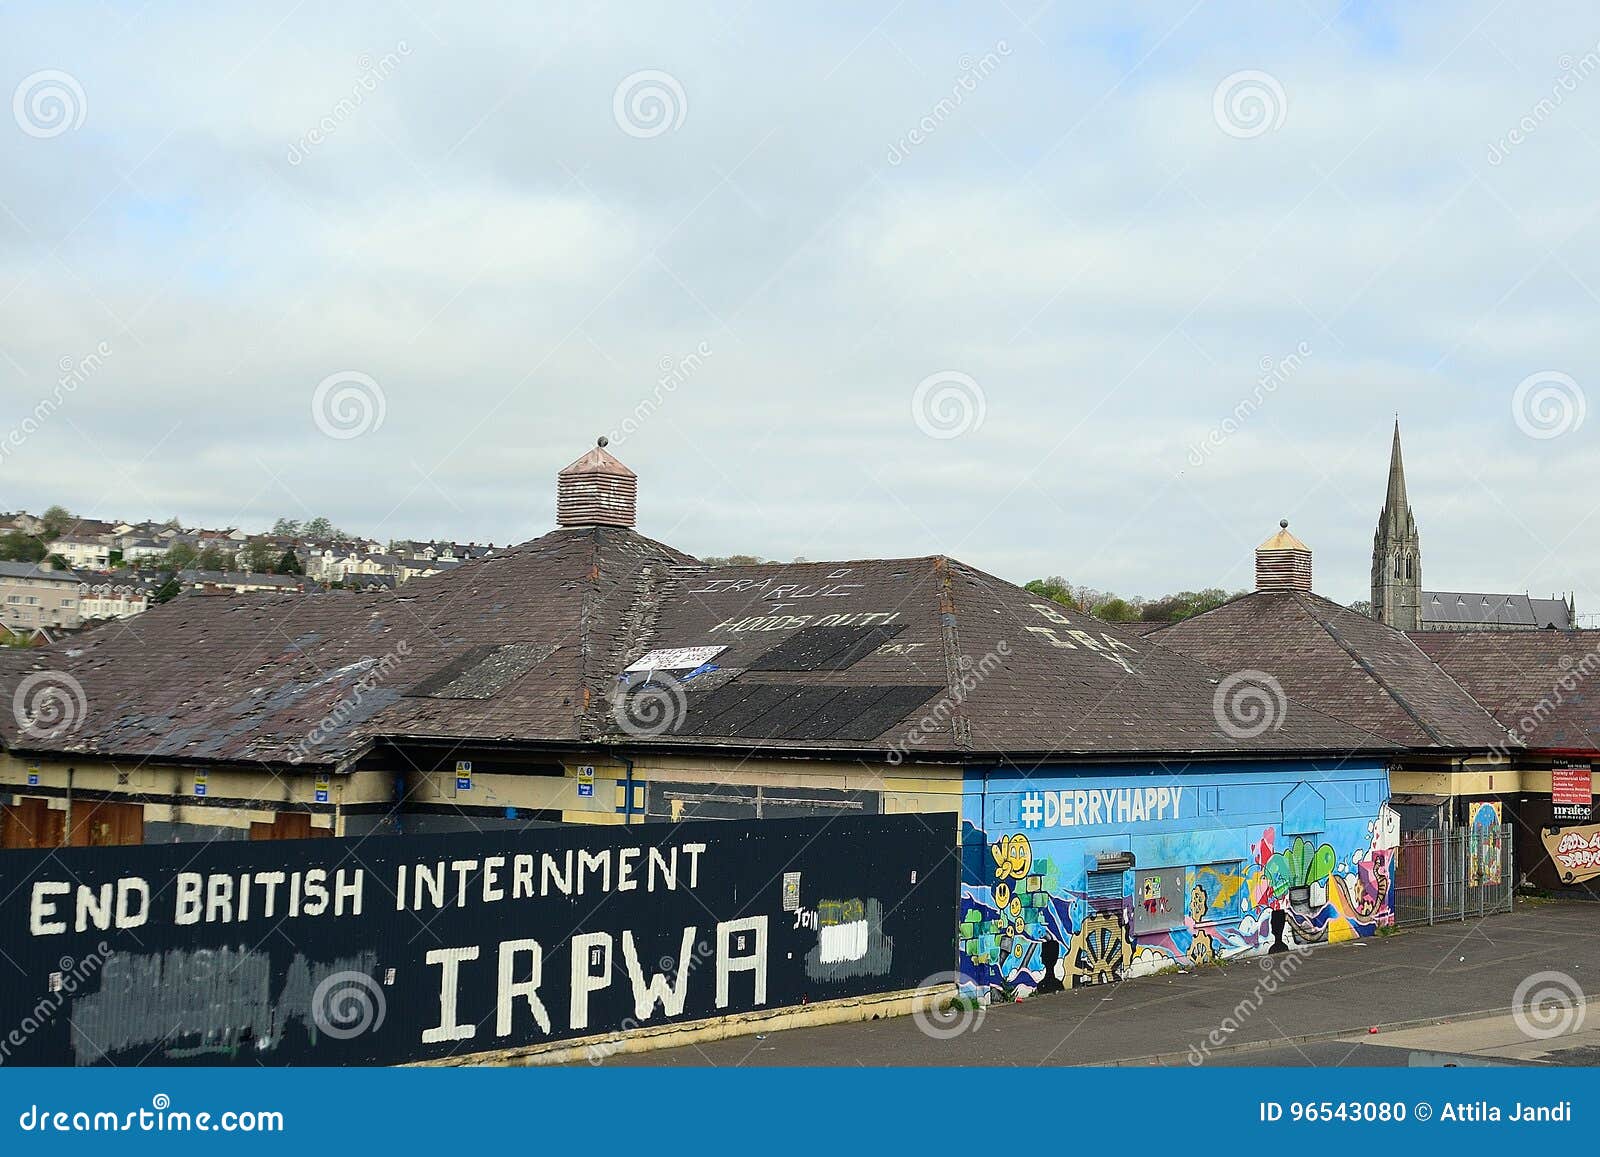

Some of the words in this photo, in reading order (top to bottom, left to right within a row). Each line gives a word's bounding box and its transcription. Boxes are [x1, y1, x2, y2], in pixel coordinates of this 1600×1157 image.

[708, 615, 814, 633] HOODS
[1021, 786, 1182, 829] #DERRYHAPPY
[30, 876, 150, 936] END
[174, 868, 364, 926] BRITISH
[396, 843, 706, 911] INTERNMENT
[421, 914, 769, 1044] IRPWA
